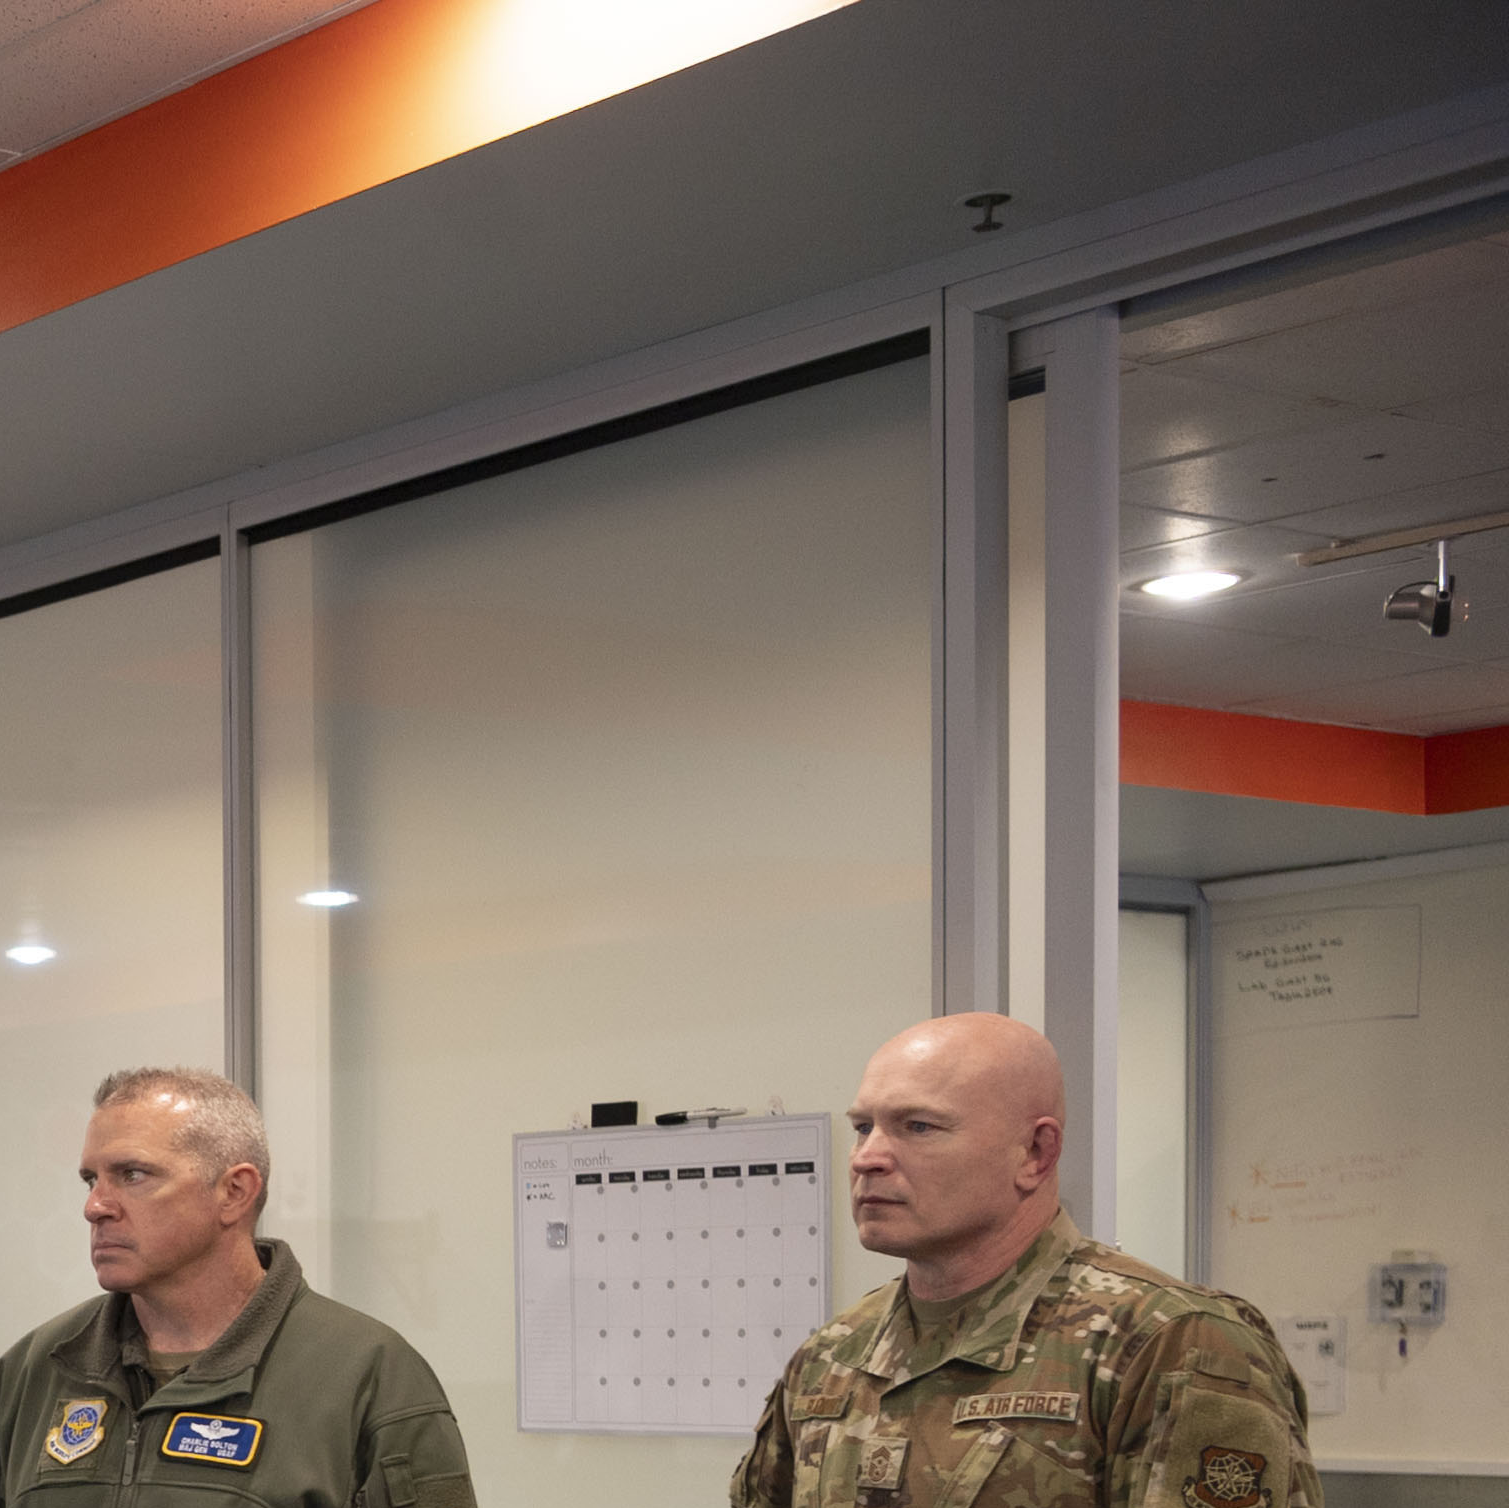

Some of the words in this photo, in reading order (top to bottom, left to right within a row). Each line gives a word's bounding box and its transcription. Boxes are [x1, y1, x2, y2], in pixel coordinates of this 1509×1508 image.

[957, 1399, 980, 1419] U.S.
[984, 1397, 1010, 1416] AIR
[1013, 1395, 1072, 1416] FORCE
